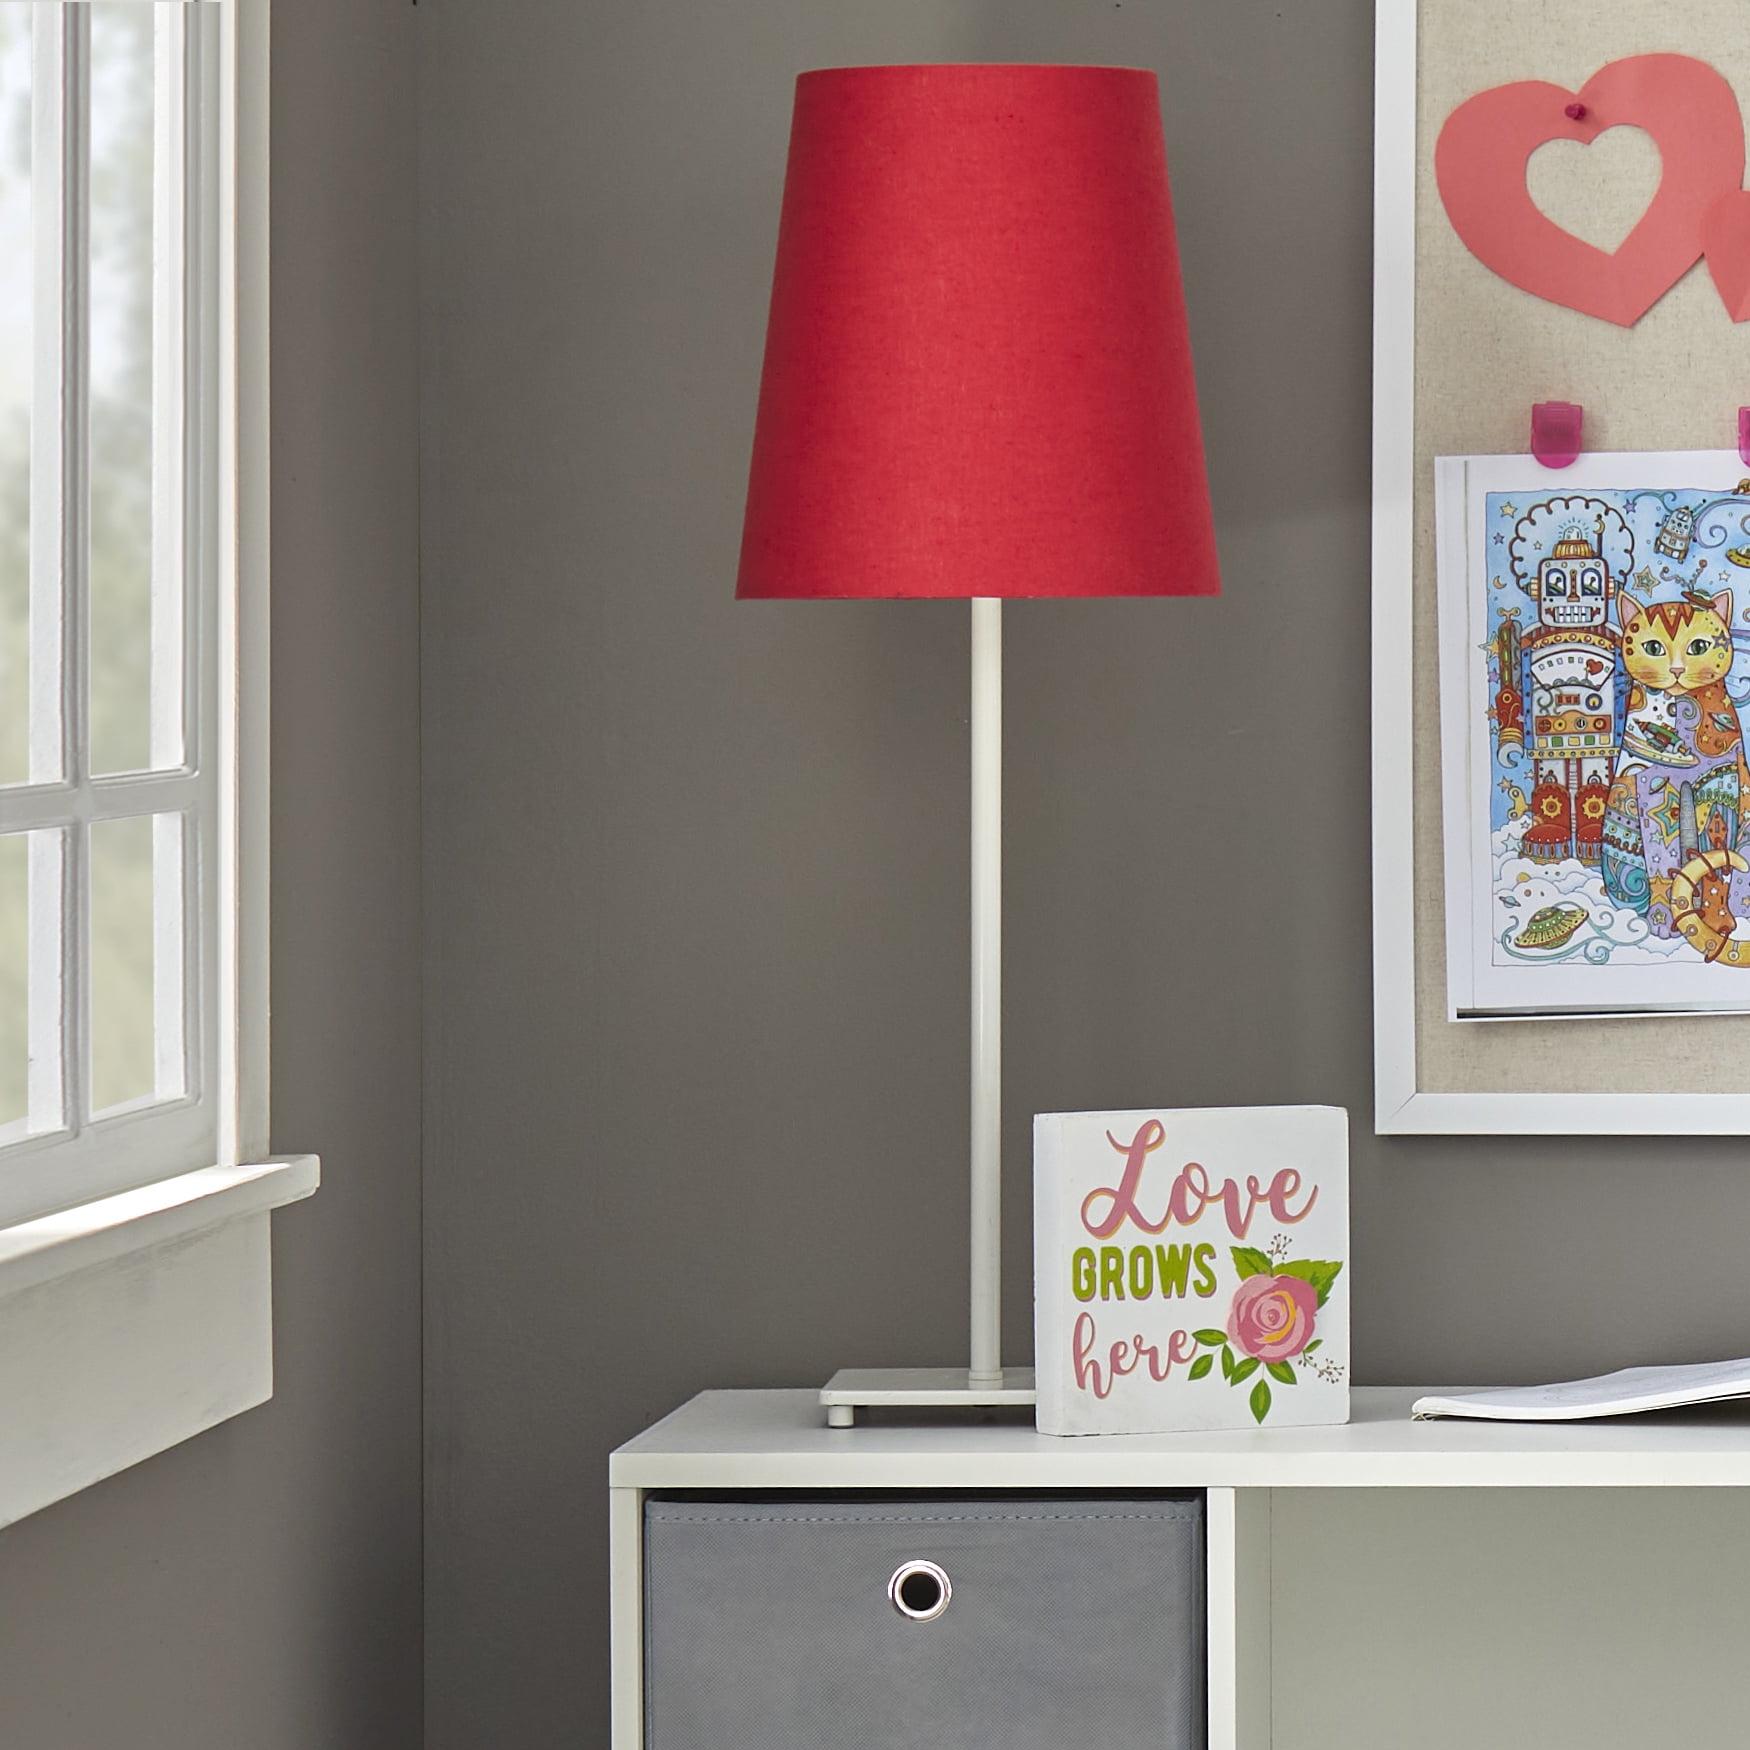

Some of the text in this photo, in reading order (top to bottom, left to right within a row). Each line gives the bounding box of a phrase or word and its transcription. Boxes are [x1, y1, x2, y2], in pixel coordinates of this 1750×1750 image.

[1081, 1119, 1319, 1240] Love
[1072, 1243, 1217, 1302] GROWS
[1073, 1312, 1199, 1400] here
